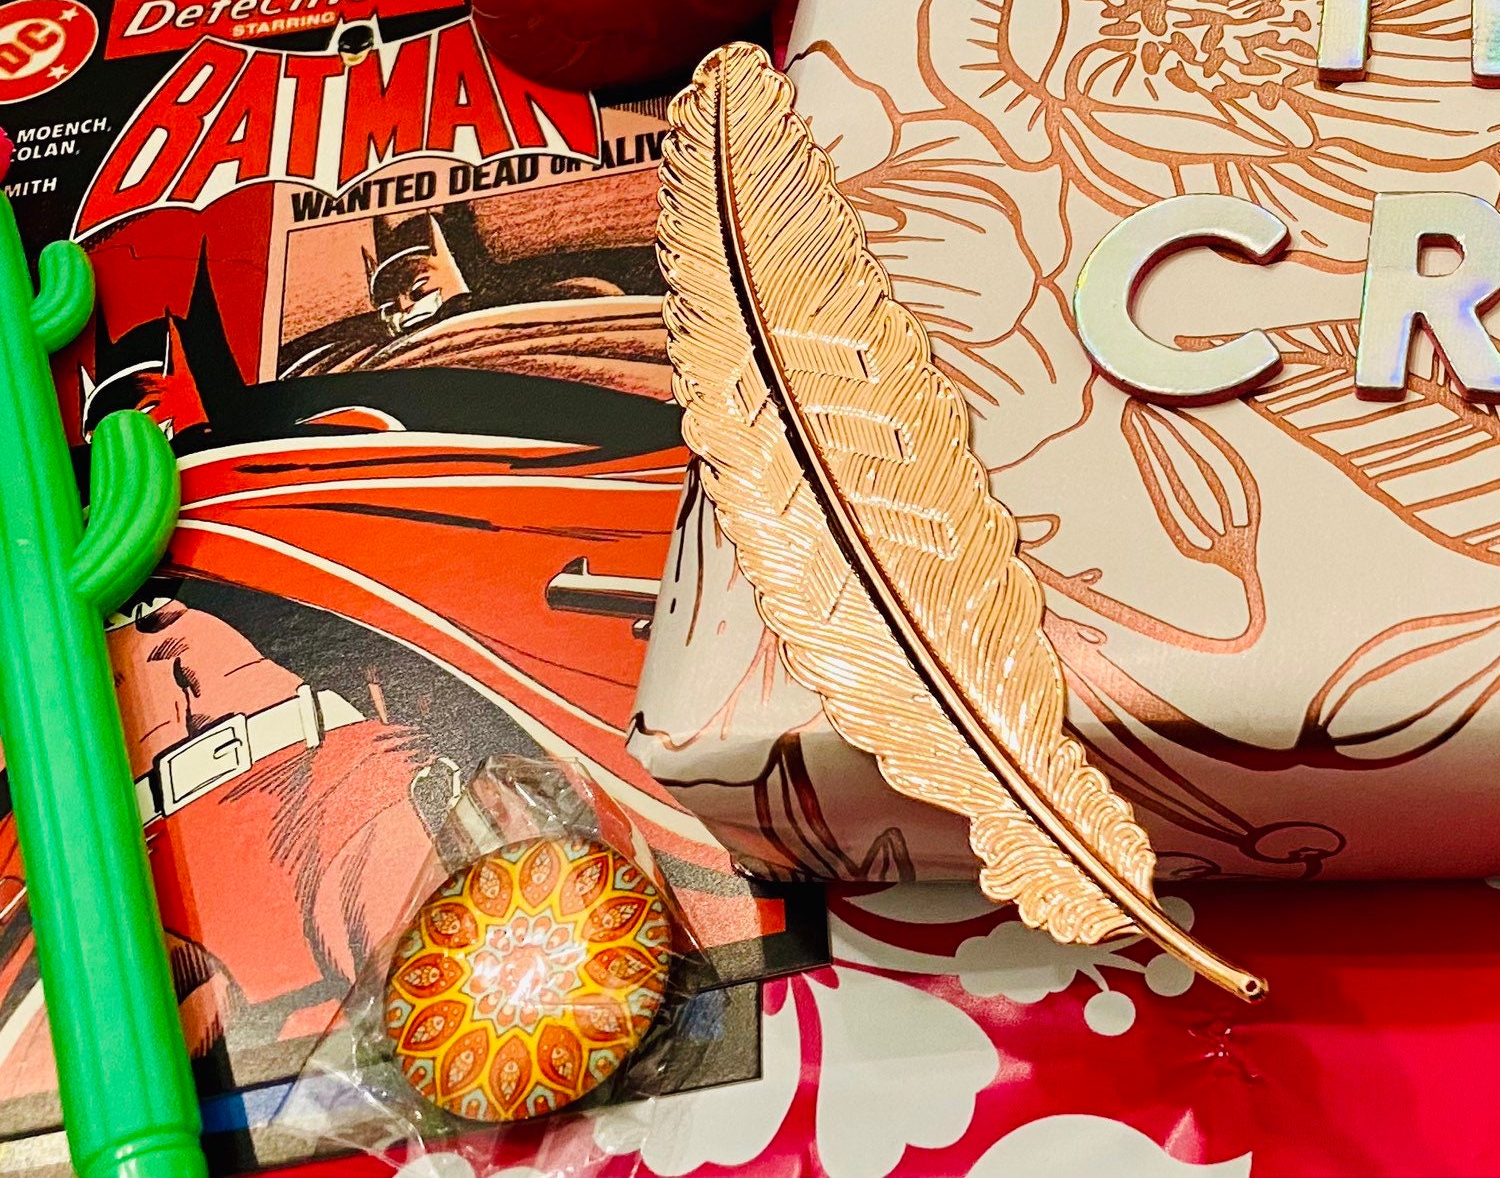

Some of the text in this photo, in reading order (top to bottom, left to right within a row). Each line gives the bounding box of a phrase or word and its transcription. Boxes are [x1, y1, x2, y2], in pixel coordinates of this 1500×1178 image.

[233, 11, 336, 39] STARRING
[74, 18, 602, 238] BATMAN
[10, 140, 80, 162] OLAN,
[4, 177, 58, 198] MITH
[291, 170, 437, 223] WANTED
[449, 154, 540, 195] DEAD
[592, 129, 668, 173] ALIV
